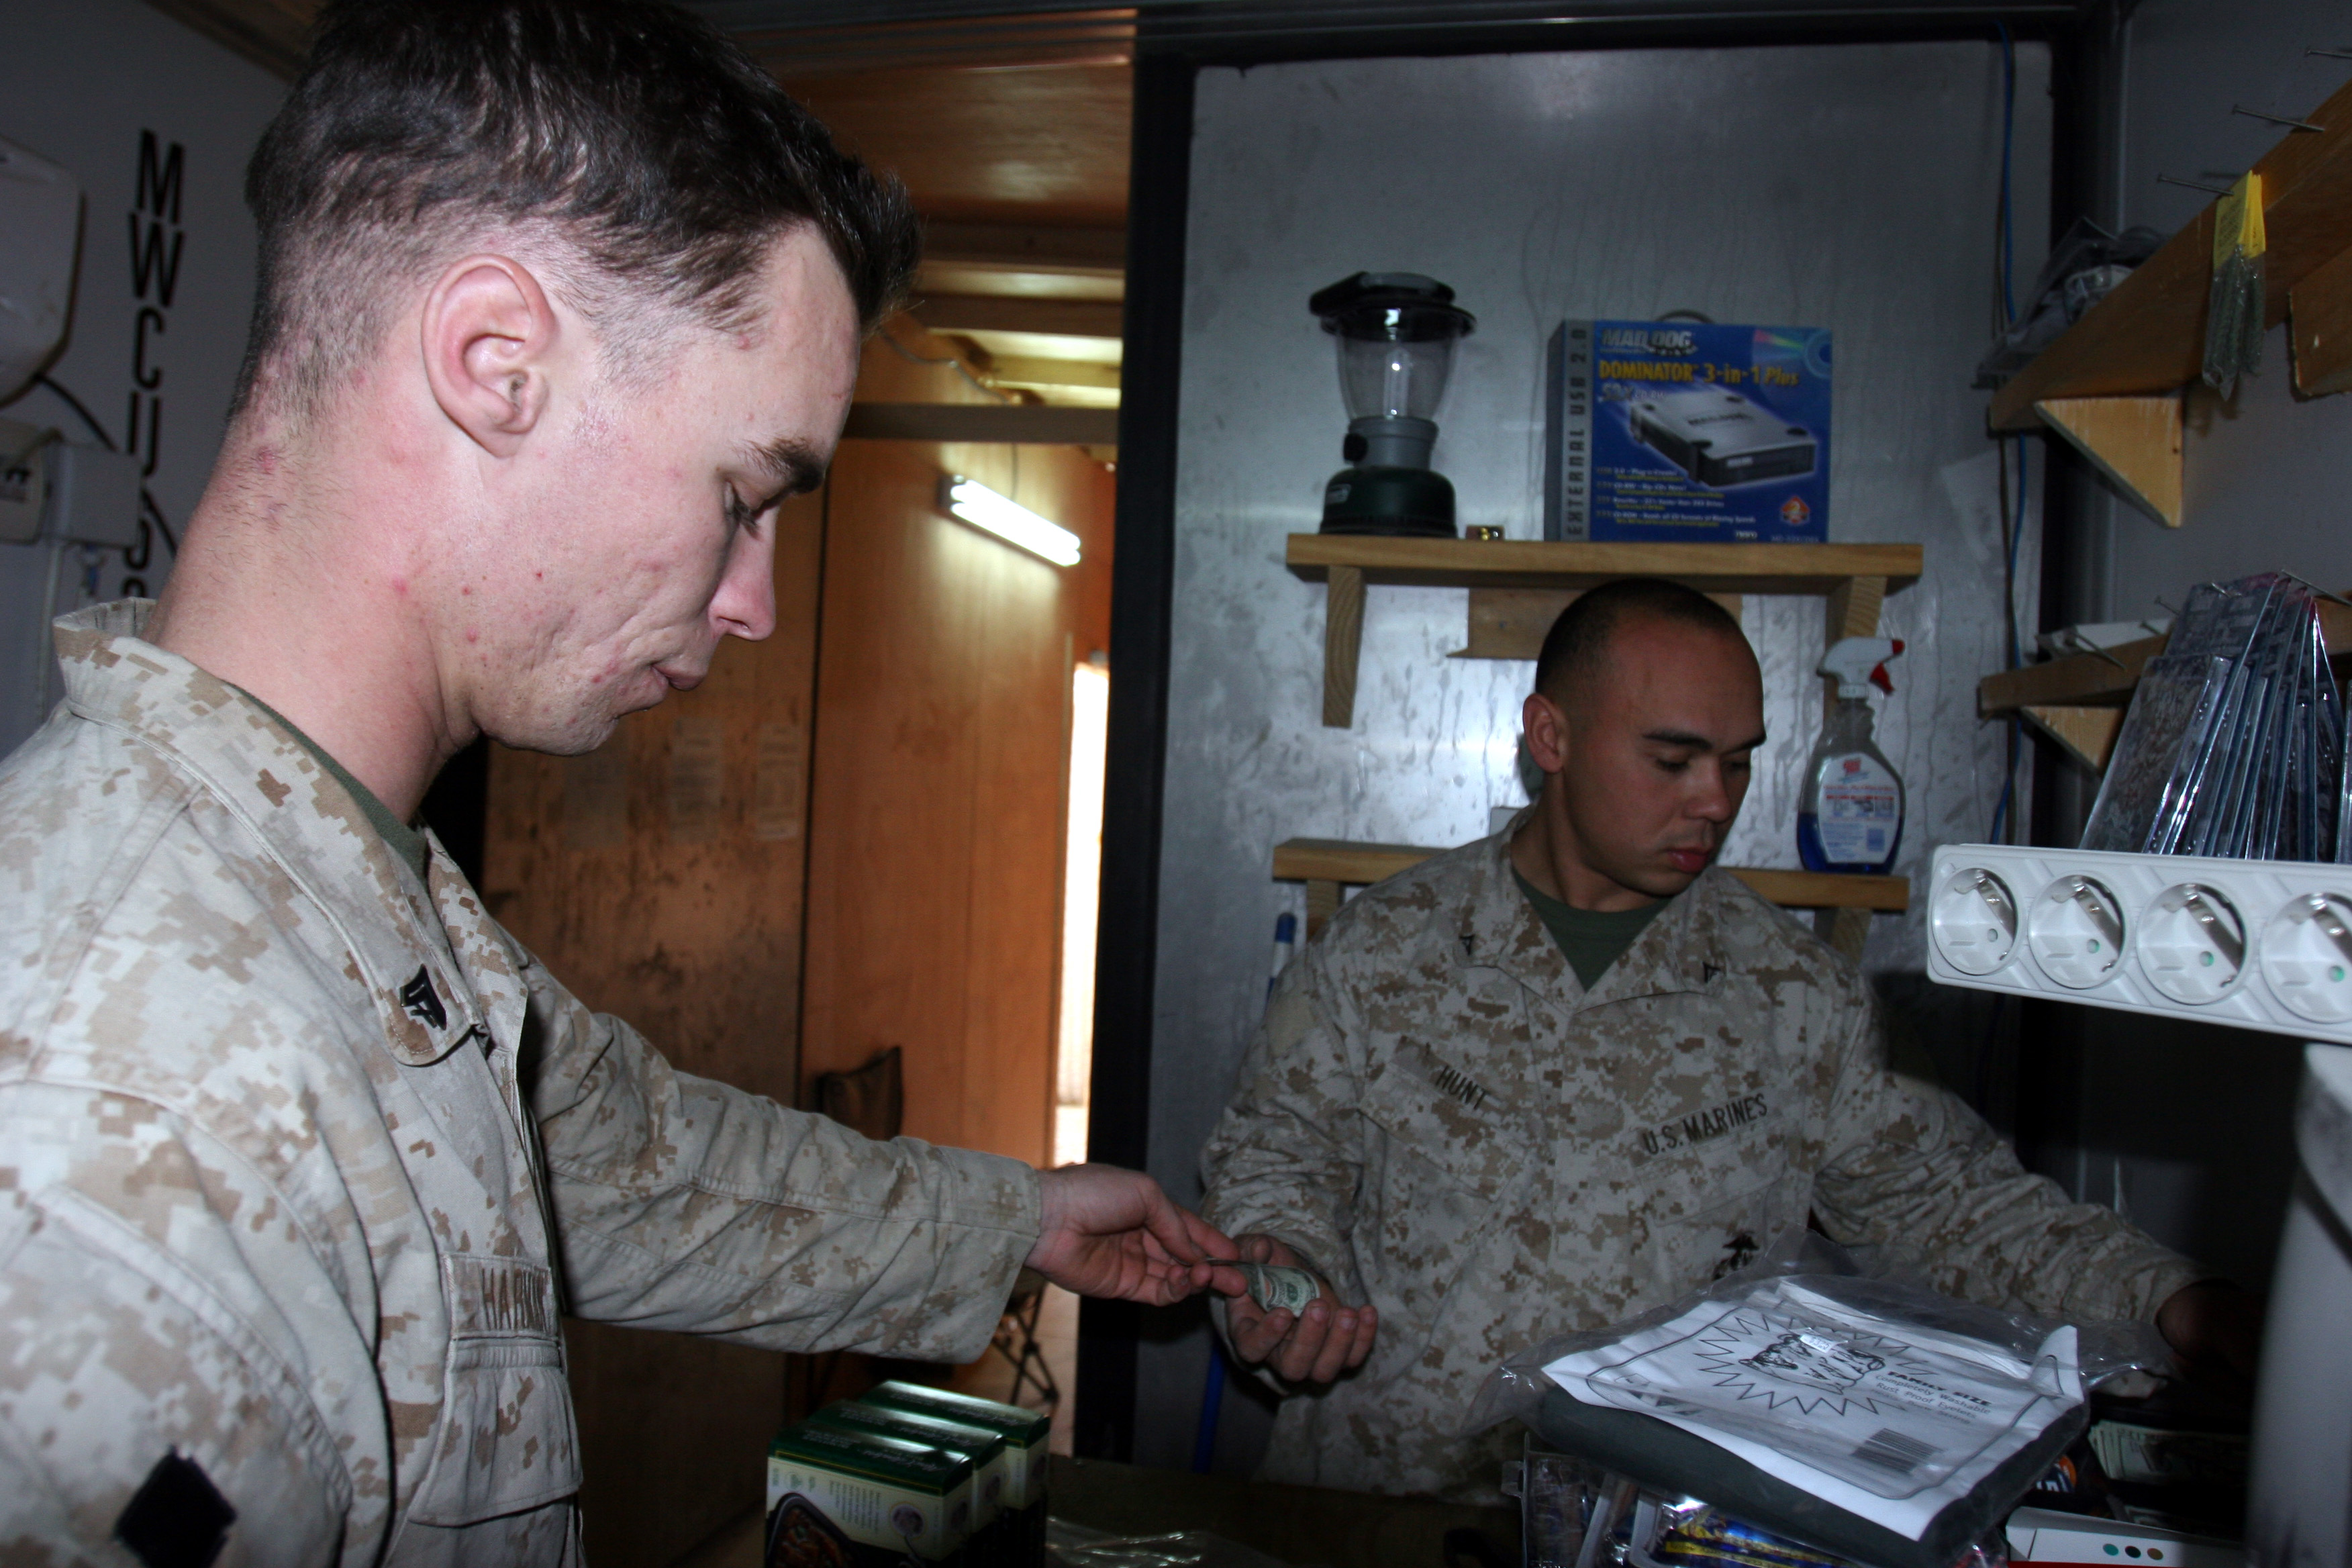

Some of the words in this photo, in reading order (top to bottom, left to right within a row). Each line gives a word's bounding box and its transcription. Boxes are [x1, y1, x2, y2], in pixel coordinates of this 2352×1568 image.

[1599, 360, 1694, 382] DOMINATOR
[1764, 366, 1800, 386] Plus
[1435, 1065, 1489, 1111] HUNT
[1875, 1375, 1934, 1396] Completely
[1940, 1393, 1992, 1414] Washable
[1876, 1382, 1900, 1395] Rust
[1904, 1391, 1934, 1404] Proof
[1888, 1371, 1947, 1391] FAMILY
[1953, 1391, 1992, 1406] SIZE
